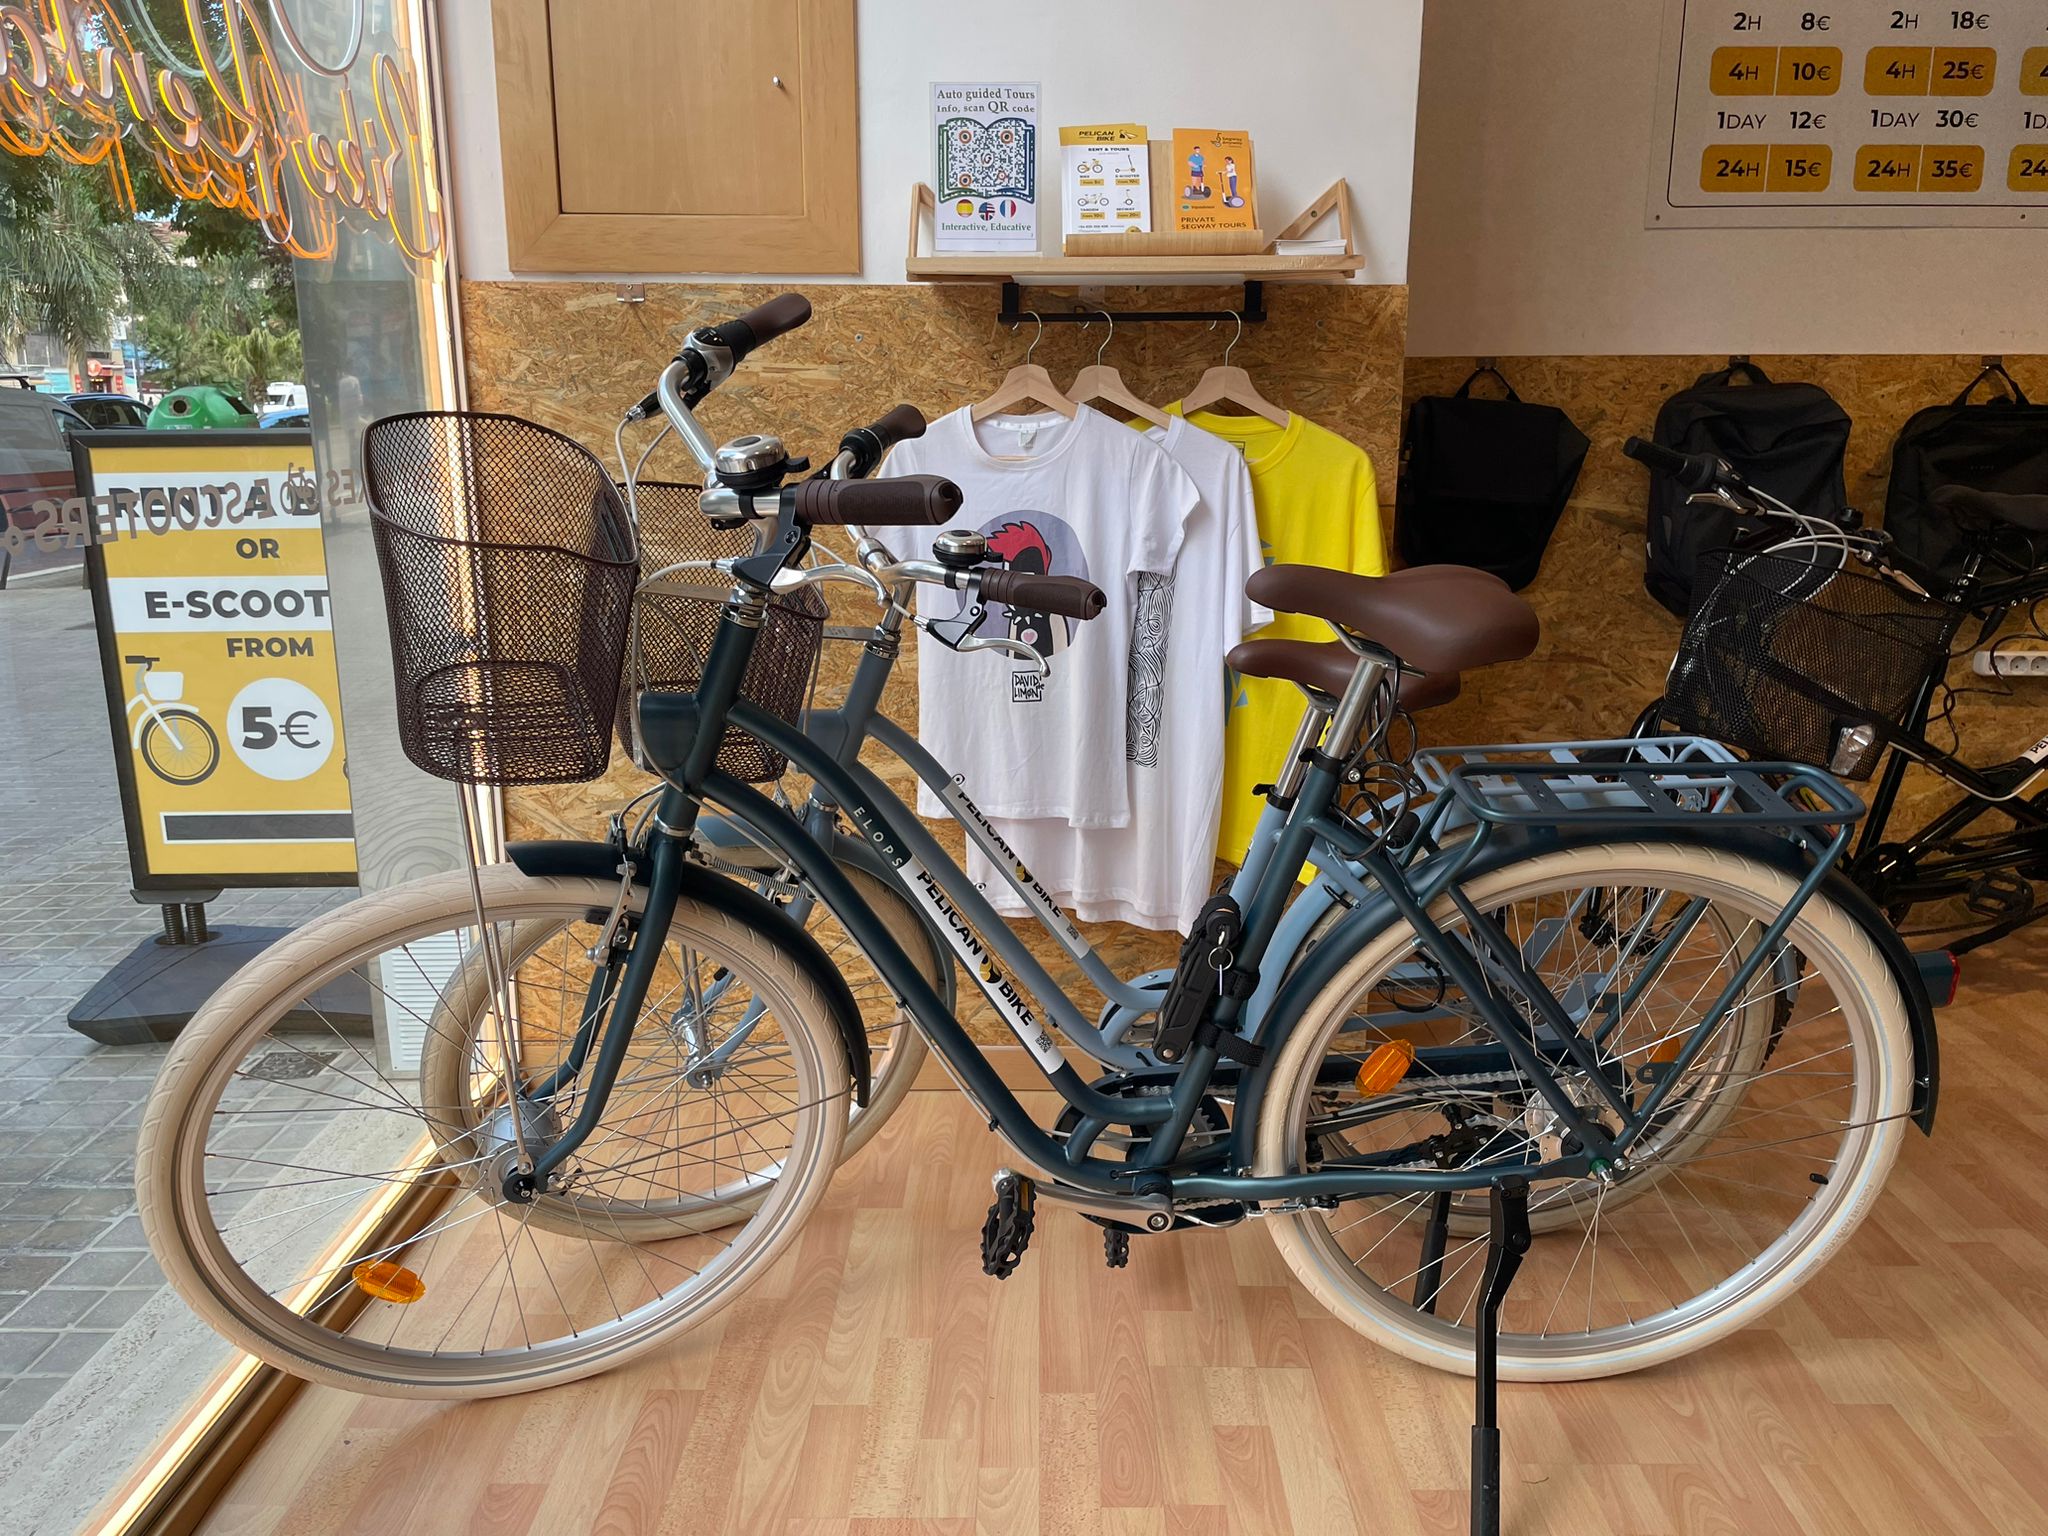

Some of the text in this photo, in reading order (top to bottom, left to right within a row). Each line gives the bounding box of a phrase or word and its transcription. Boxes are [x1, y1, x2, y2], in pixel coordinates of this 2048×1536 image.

[1733, 12, 1831, 31] 2H 8€
[1890, 10, 1990, 30] 2H 18€
[1728, 62, 1832, 81] 4H 10€
[1885, 60, 1985, 80] 4H 25€
[937, 88, 1035, 101] Auto guided Tours
[937, 104, 961, 113] Info,
[987, 101, 1009, 114] QR
[1717, 111, 1827, 130] 1DAY 12€
[1870, 109, 1979, 129] 1DAY 30€
[1716, 159, 1822, 178] 24H 15€
[1867, 159, 1974, 178] 24H 35€
[941, 223, 1032, 232] Interactive, Educative
[235, 537, 281, 560] OR
[144, 589, 330, 619] E-SCOOT
[226, 636, 315, 658] FROM
[1014, 674, 1039, 687] DAVID
[241, 705, 322, 751] 5€
[957, 791, 1015, 860] PELICAN
[853, 806, 903, 868] ELOPS
[916, 870, 1035, 1026] PELICAN BIKE
